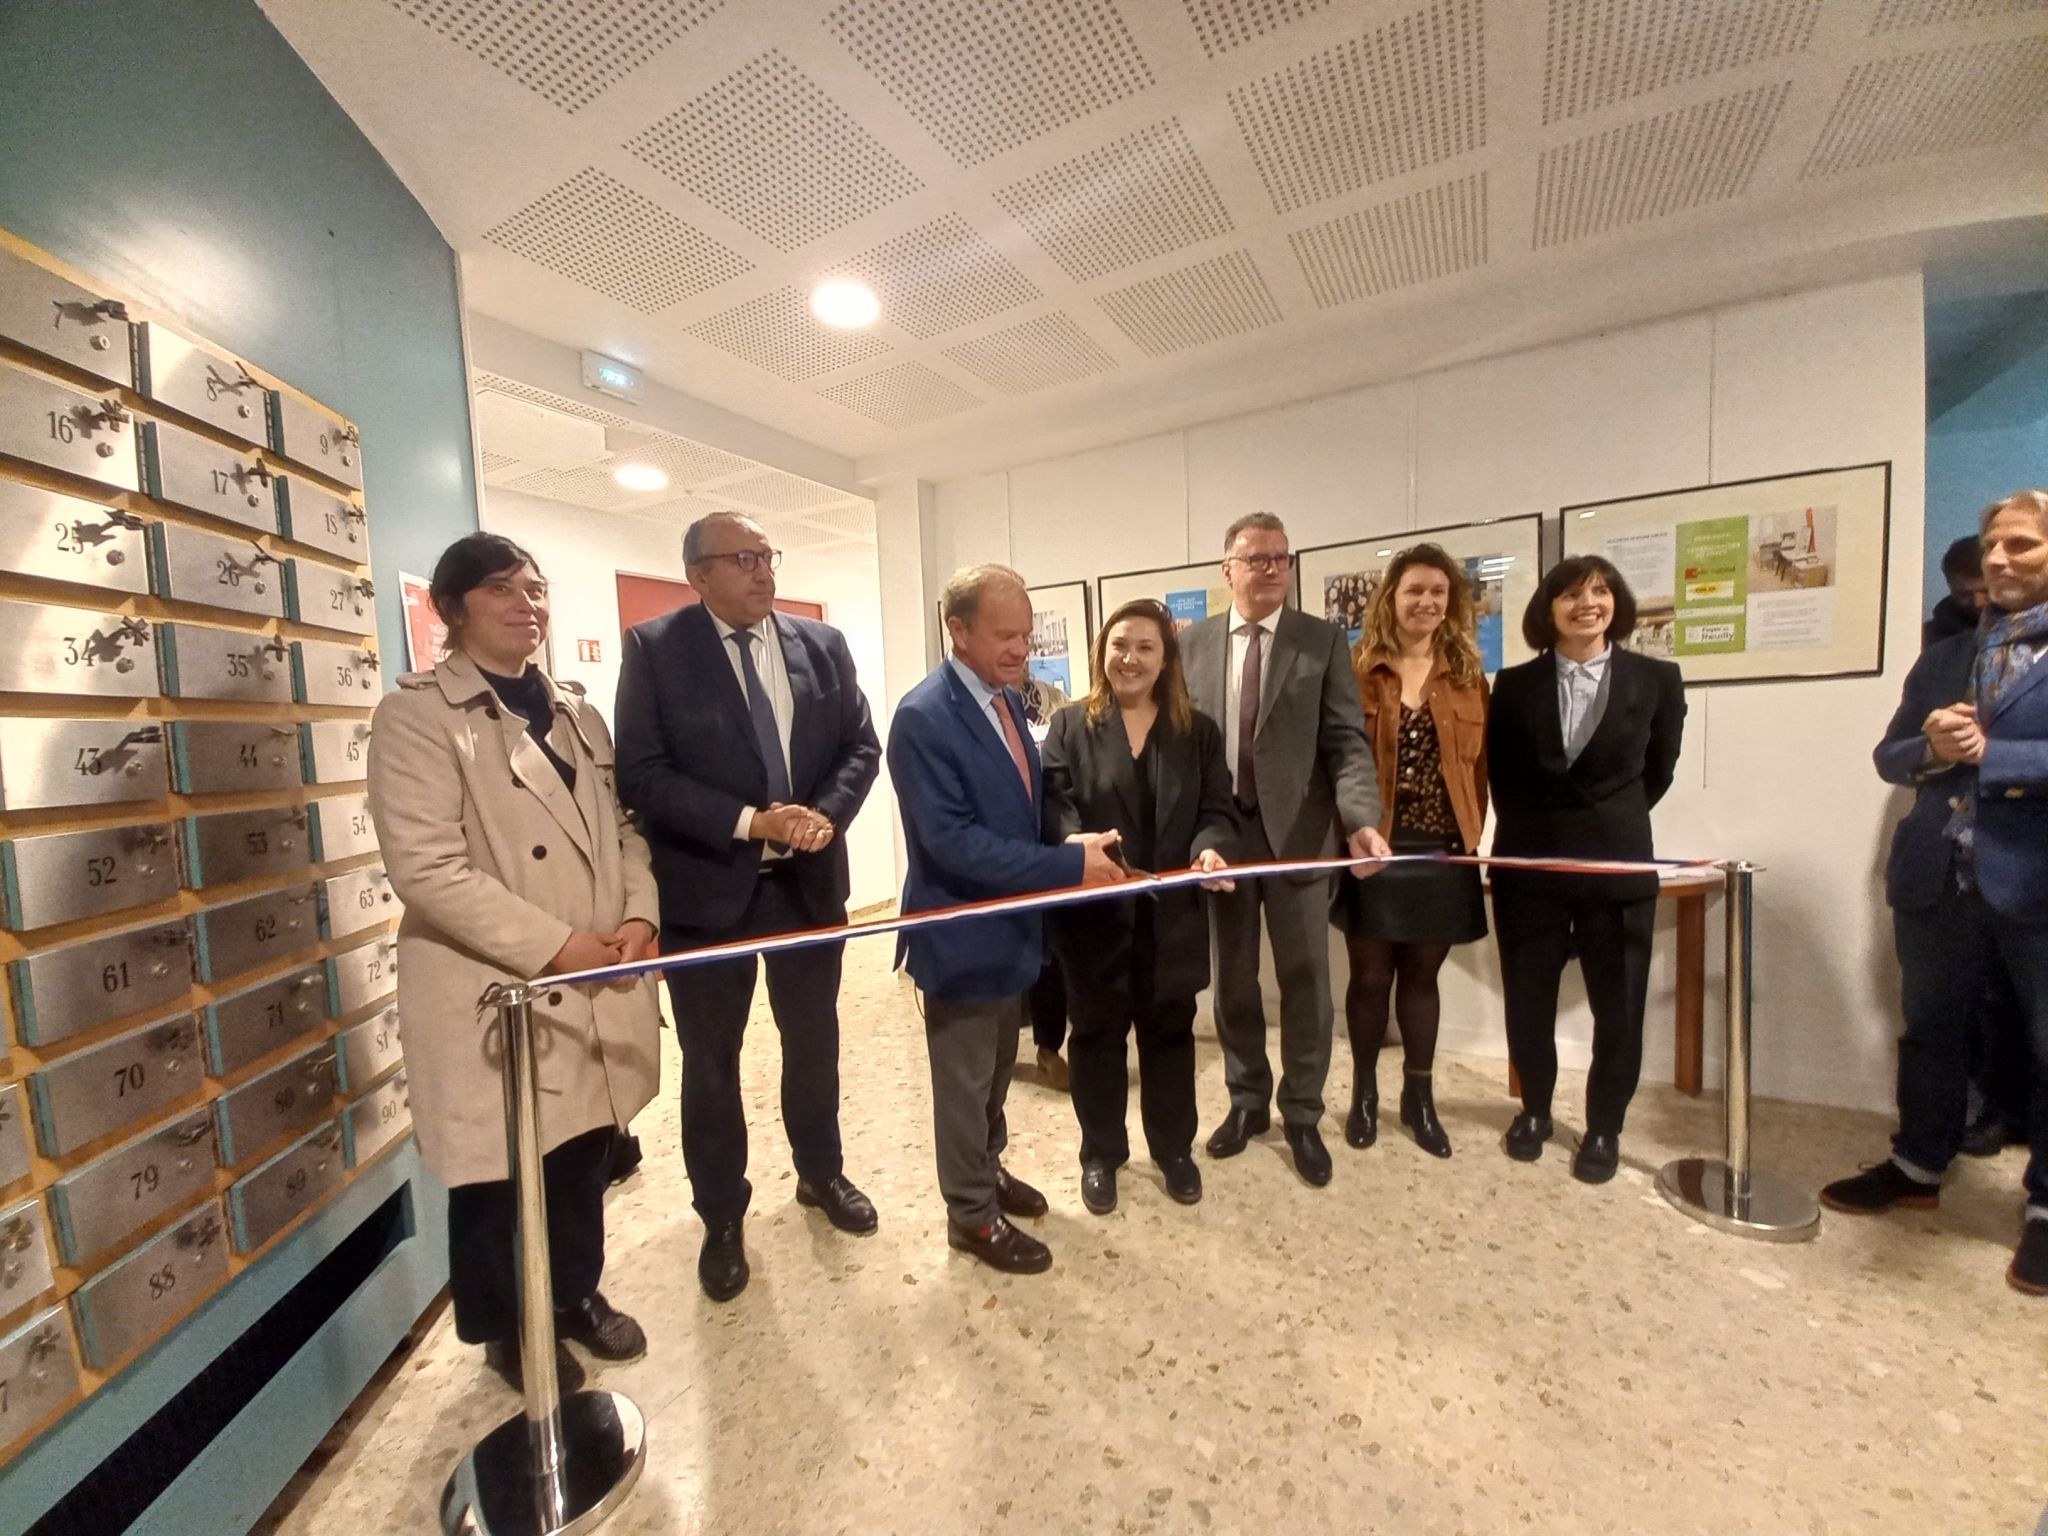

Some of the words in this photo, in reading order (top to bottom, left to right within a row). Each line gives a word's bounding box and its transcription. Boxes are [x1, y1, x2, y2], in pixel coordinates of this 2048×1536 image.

[206, 376, 219, 402] 8
[47, 411, 73, 443] 16
[320, 434, 328, 455] 9
[211, 469, 228, 495] 17
[325, 513, 337, 535] 18
[55, 523, 84, 554] 25
[217, 560, 240, 587] 26
[331, 590, 344, 611] 27
[63, 637, 95, 667] 34
[227, 653, 249, 677] 35
[337, 667, 353, 687] 36
[74, 748, 102, 776] 43
[239, 744, 258, 768] 44
[346, 741, 360, 761] 45
[352, 815, 367, 835] 54
[88, 856, 117, 887] 52
[359, 888, 375, 910] 63
[255, 916, 276, 942] 62
[103, 961, 131, 993] 61
[367, 960, 382, 983] 72
[266, 1001, 284, 1030] 71
[376, 1031, 389, 1052] 81
[113, 1063, 145, 1098] 70
[382, 1100, 397, 1124] 90
[131, 1165, 159, 1200] 79
[149, 1264, 176, 1301] 88
